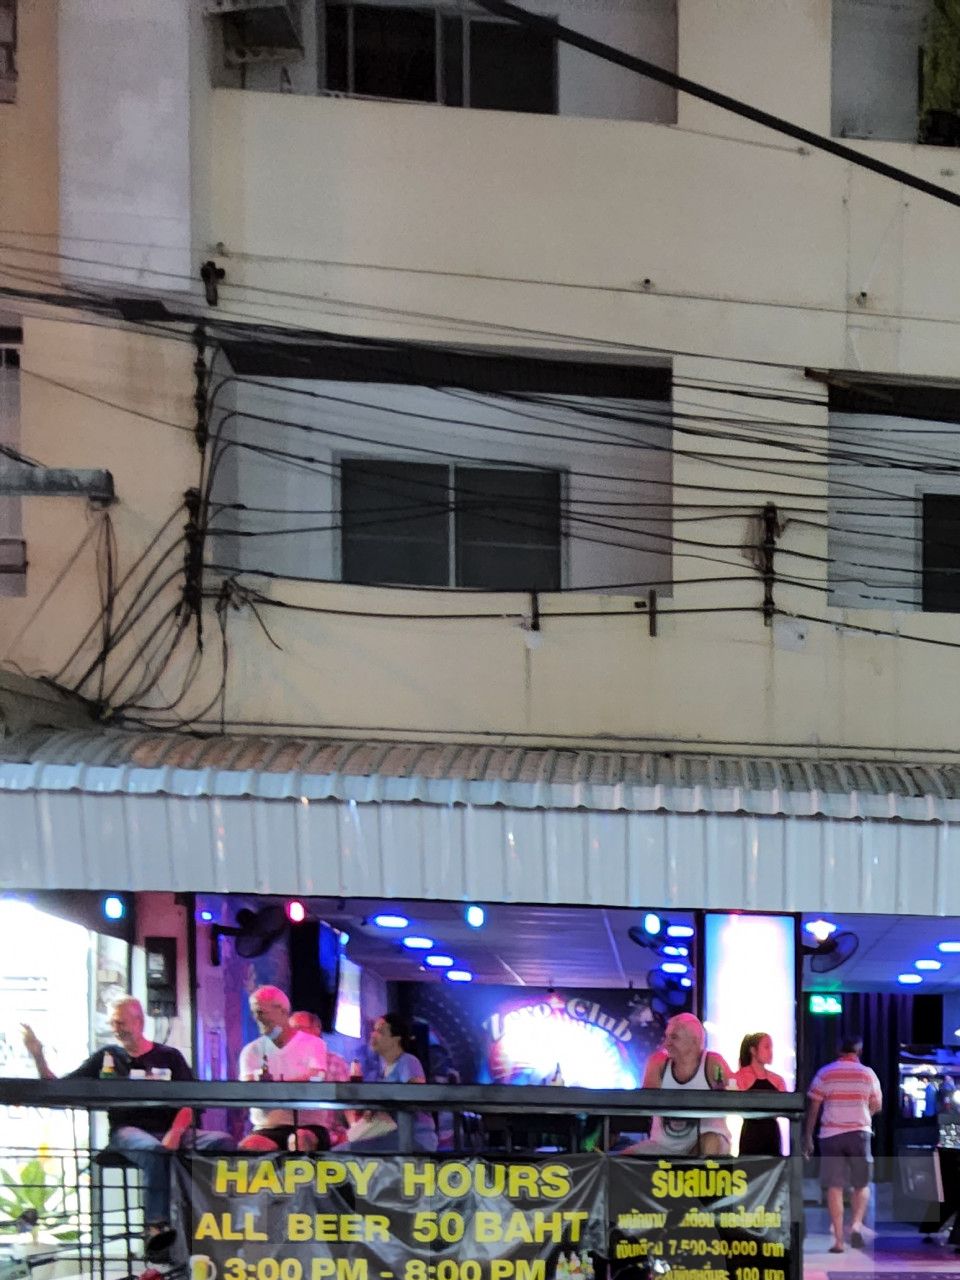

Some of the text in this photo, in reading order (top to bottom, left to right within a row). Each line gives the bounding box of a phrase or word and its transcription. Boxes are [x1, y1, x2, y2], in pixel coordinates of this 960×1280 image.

[566, 999, 632, 1042] Club
[214, 1159, 572, 1198] HAPPY HOURS
[651, 1159, 749, 1198] รับสมัคร
[194, 1209, 590, 1244] ALL BEER 50 BAHT
